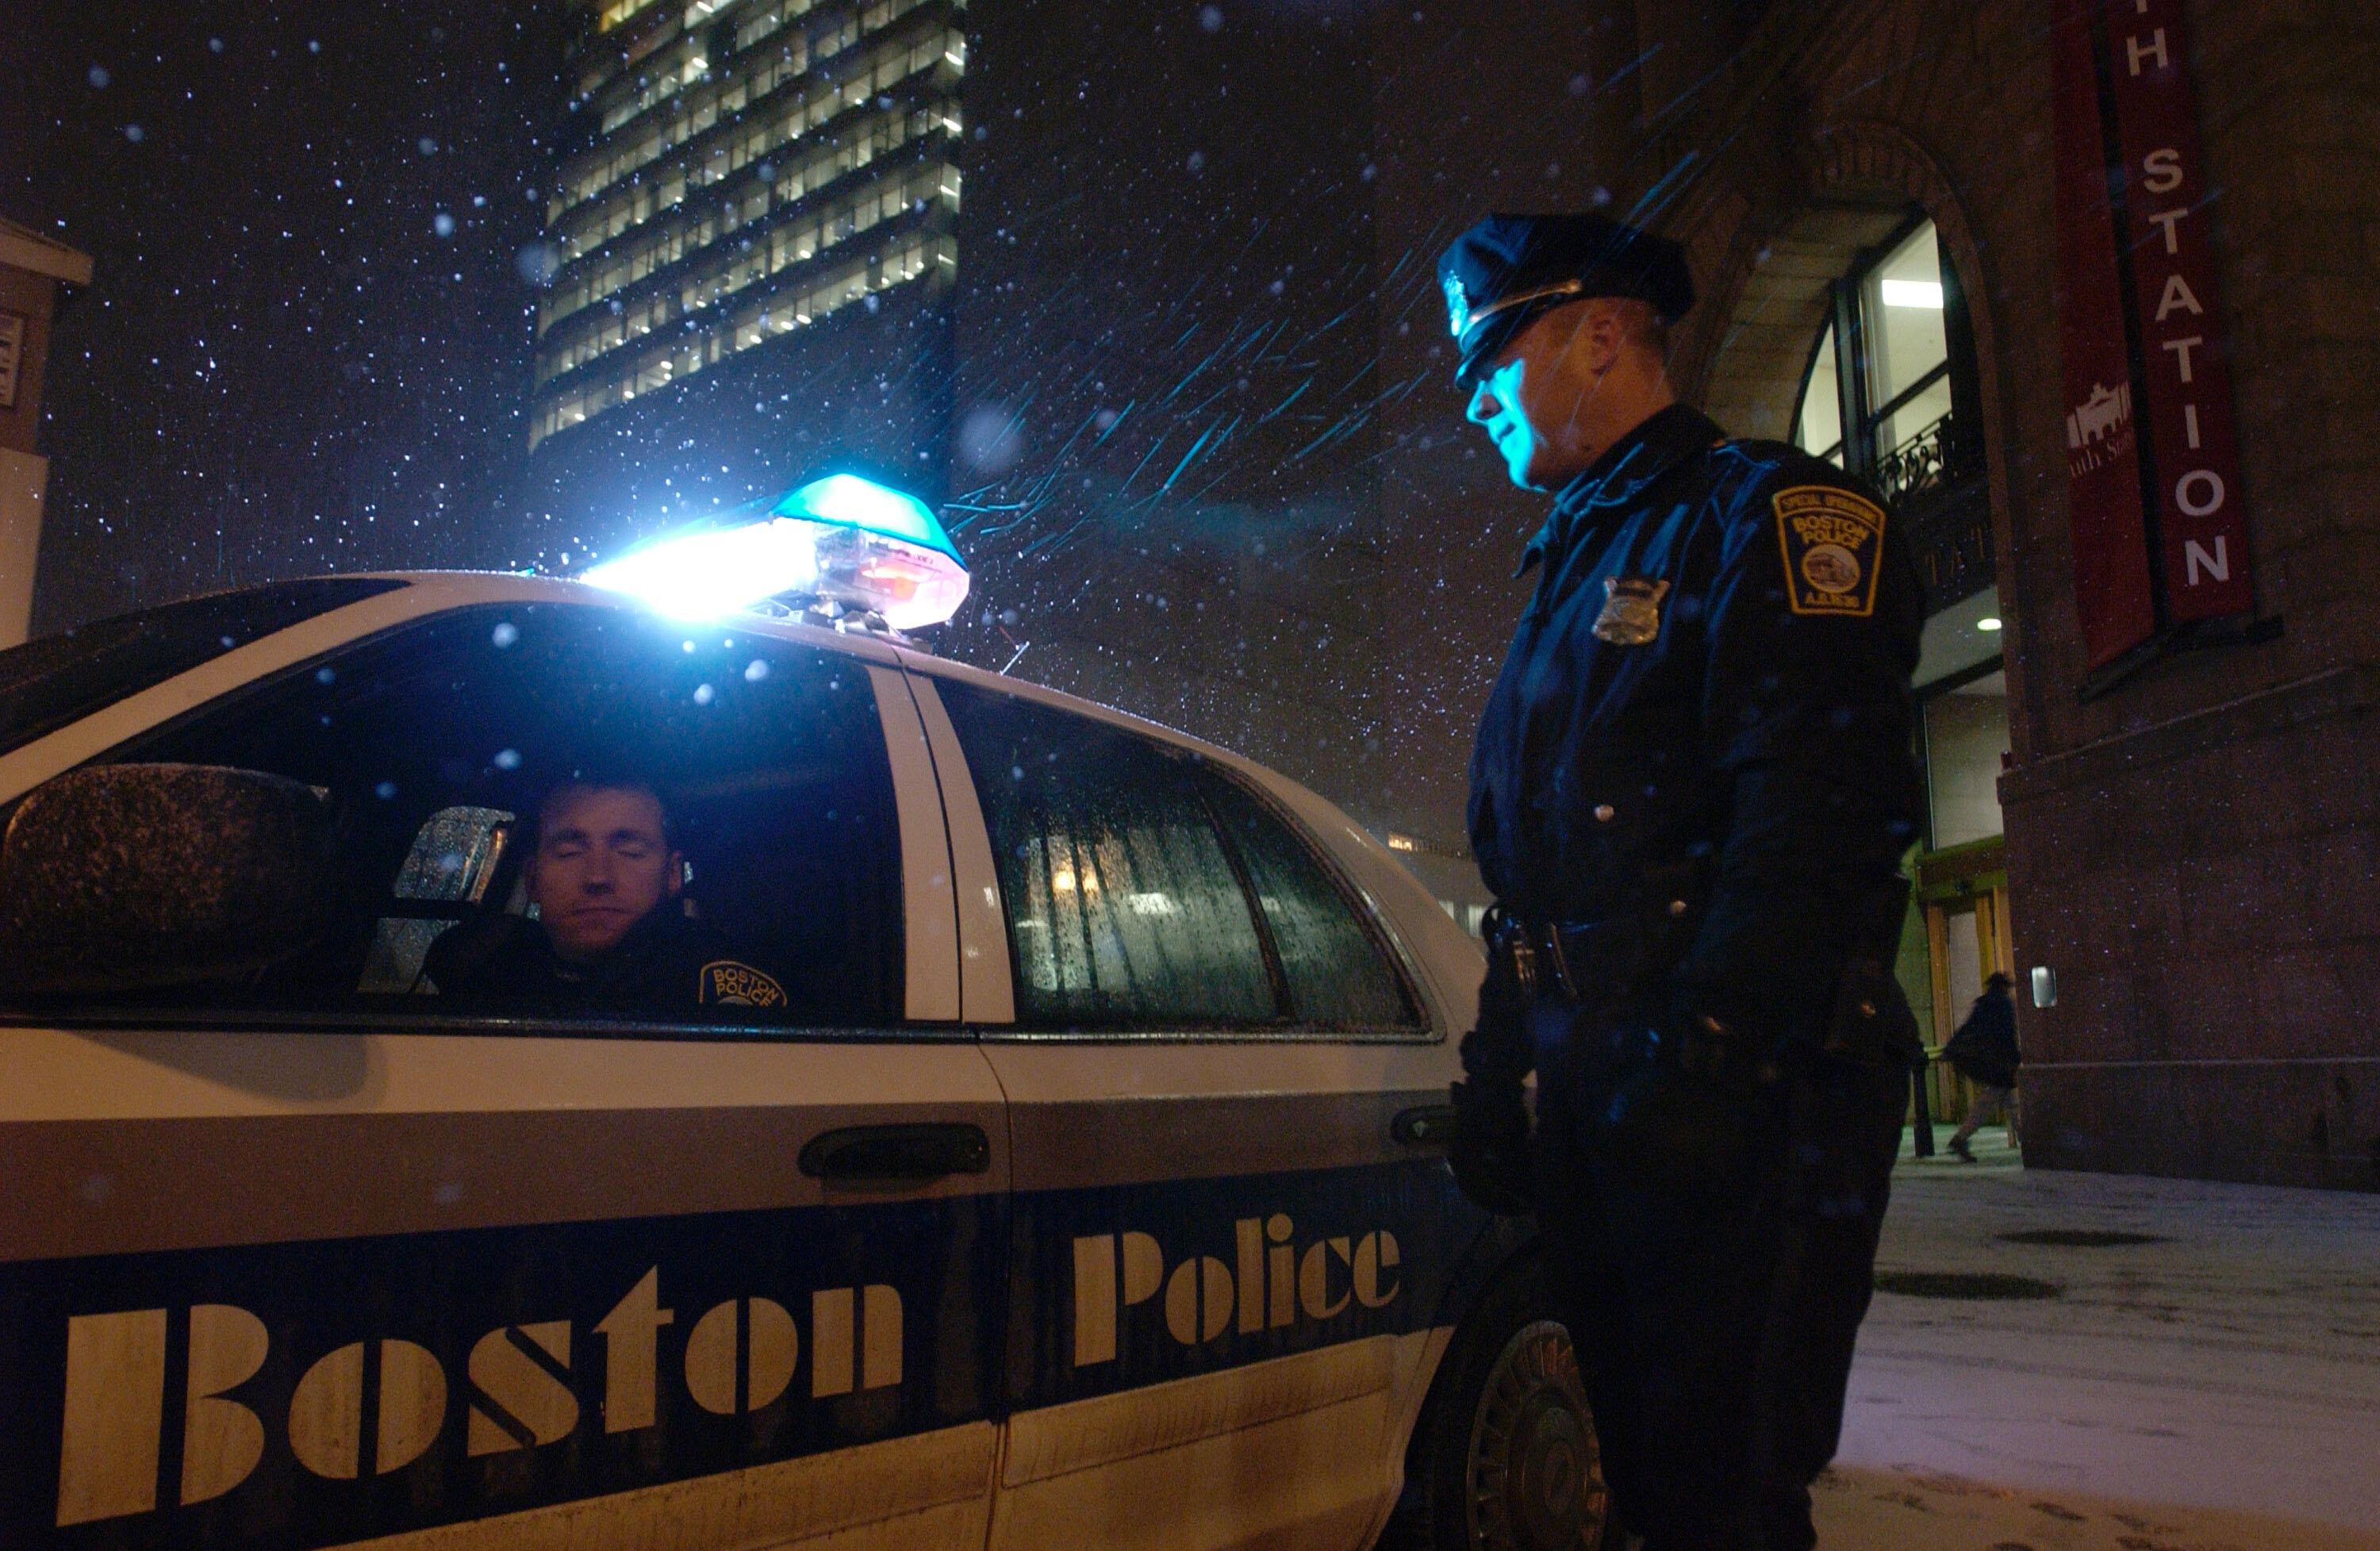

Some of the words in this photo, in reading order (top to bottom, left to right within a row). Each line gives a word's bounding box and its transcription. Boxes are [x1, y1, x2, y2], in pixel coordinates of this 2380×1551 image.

[2126, 0, 2168, 77] H
[2143, 148, 2229, 586] STATION
[1793, 515, 1870, 540] BOSTON
[1802, 528, 1863, 550] POLICE
[714, 968, 779, 1003] BOSTON
[716, 981, 772, 1008] POLICE
[56, 1264, 904, 1528] Boston
[1073, 1212, 1401, 1367] Police
